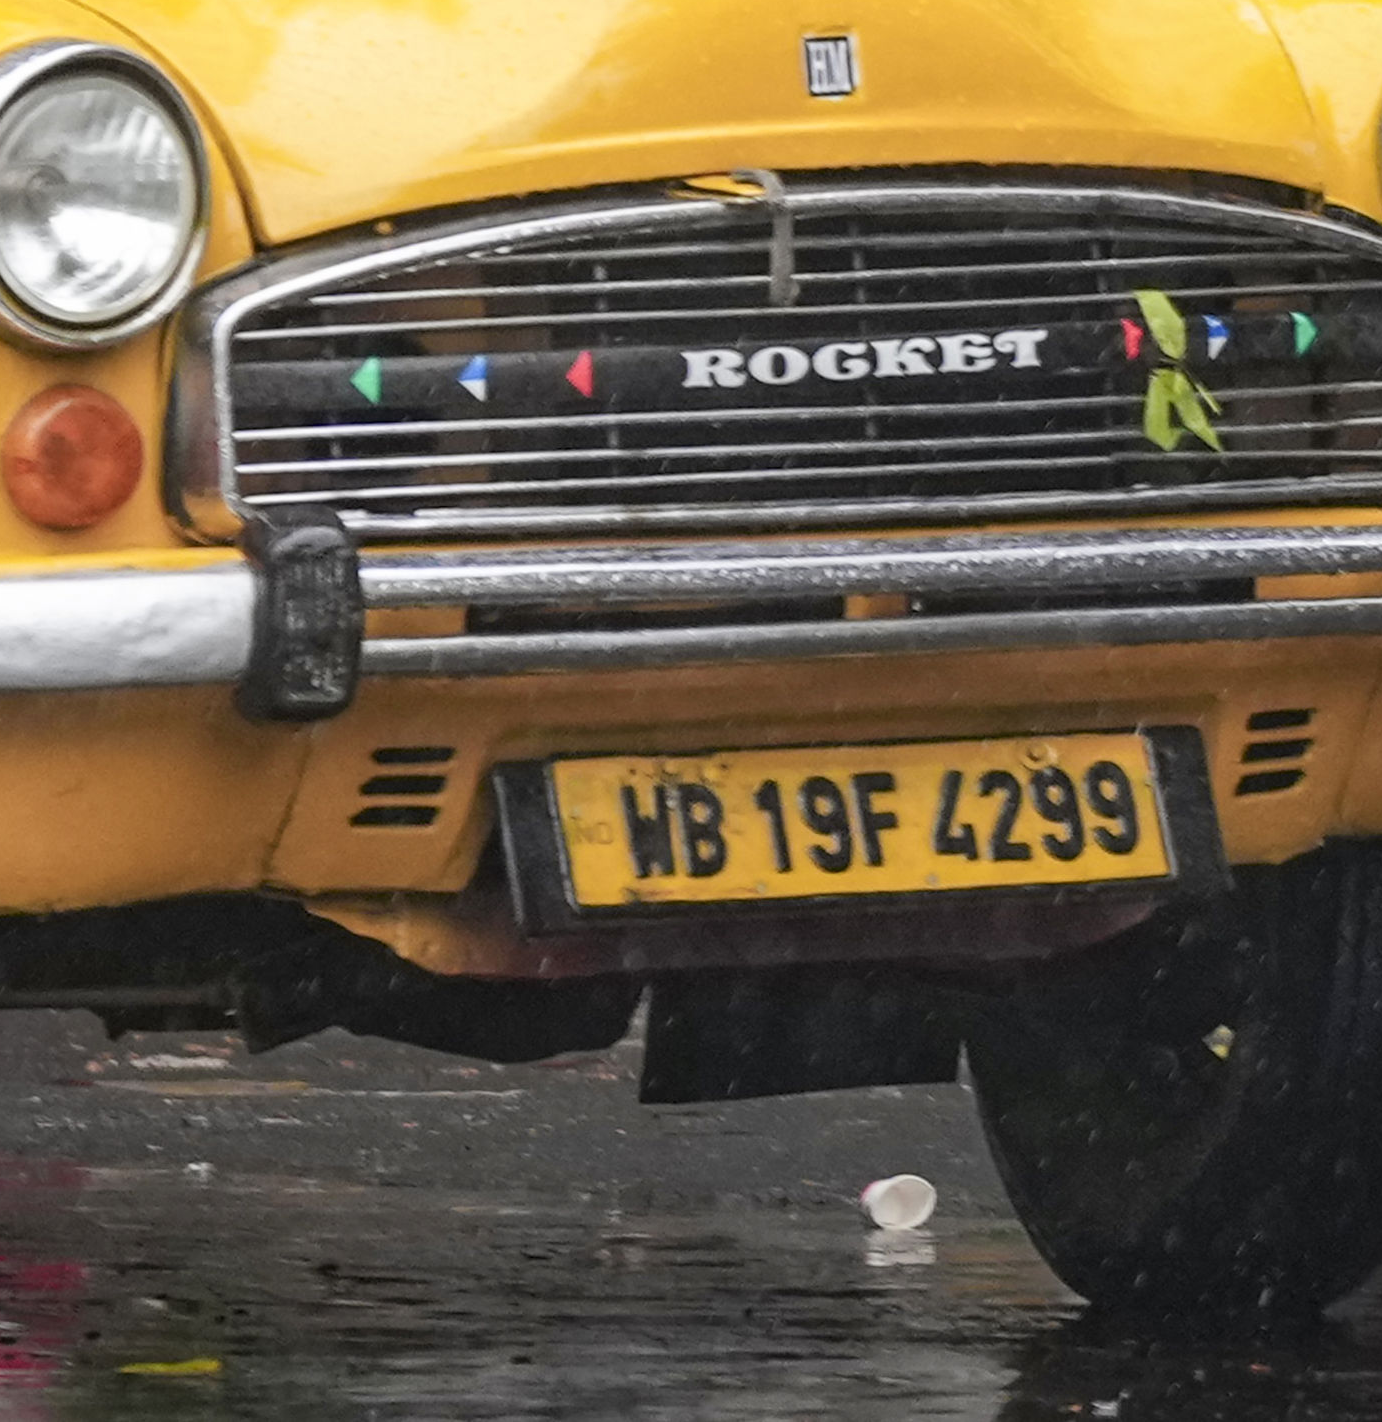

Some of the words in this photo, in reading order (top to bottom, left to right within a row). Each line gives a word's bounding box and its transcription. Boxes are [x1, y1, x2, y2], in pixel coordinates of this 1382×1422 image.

[620, 783, 728, 878] WB
[753, 771, 899, 874] 19F
[933, 760, 1139, 862] 4299
